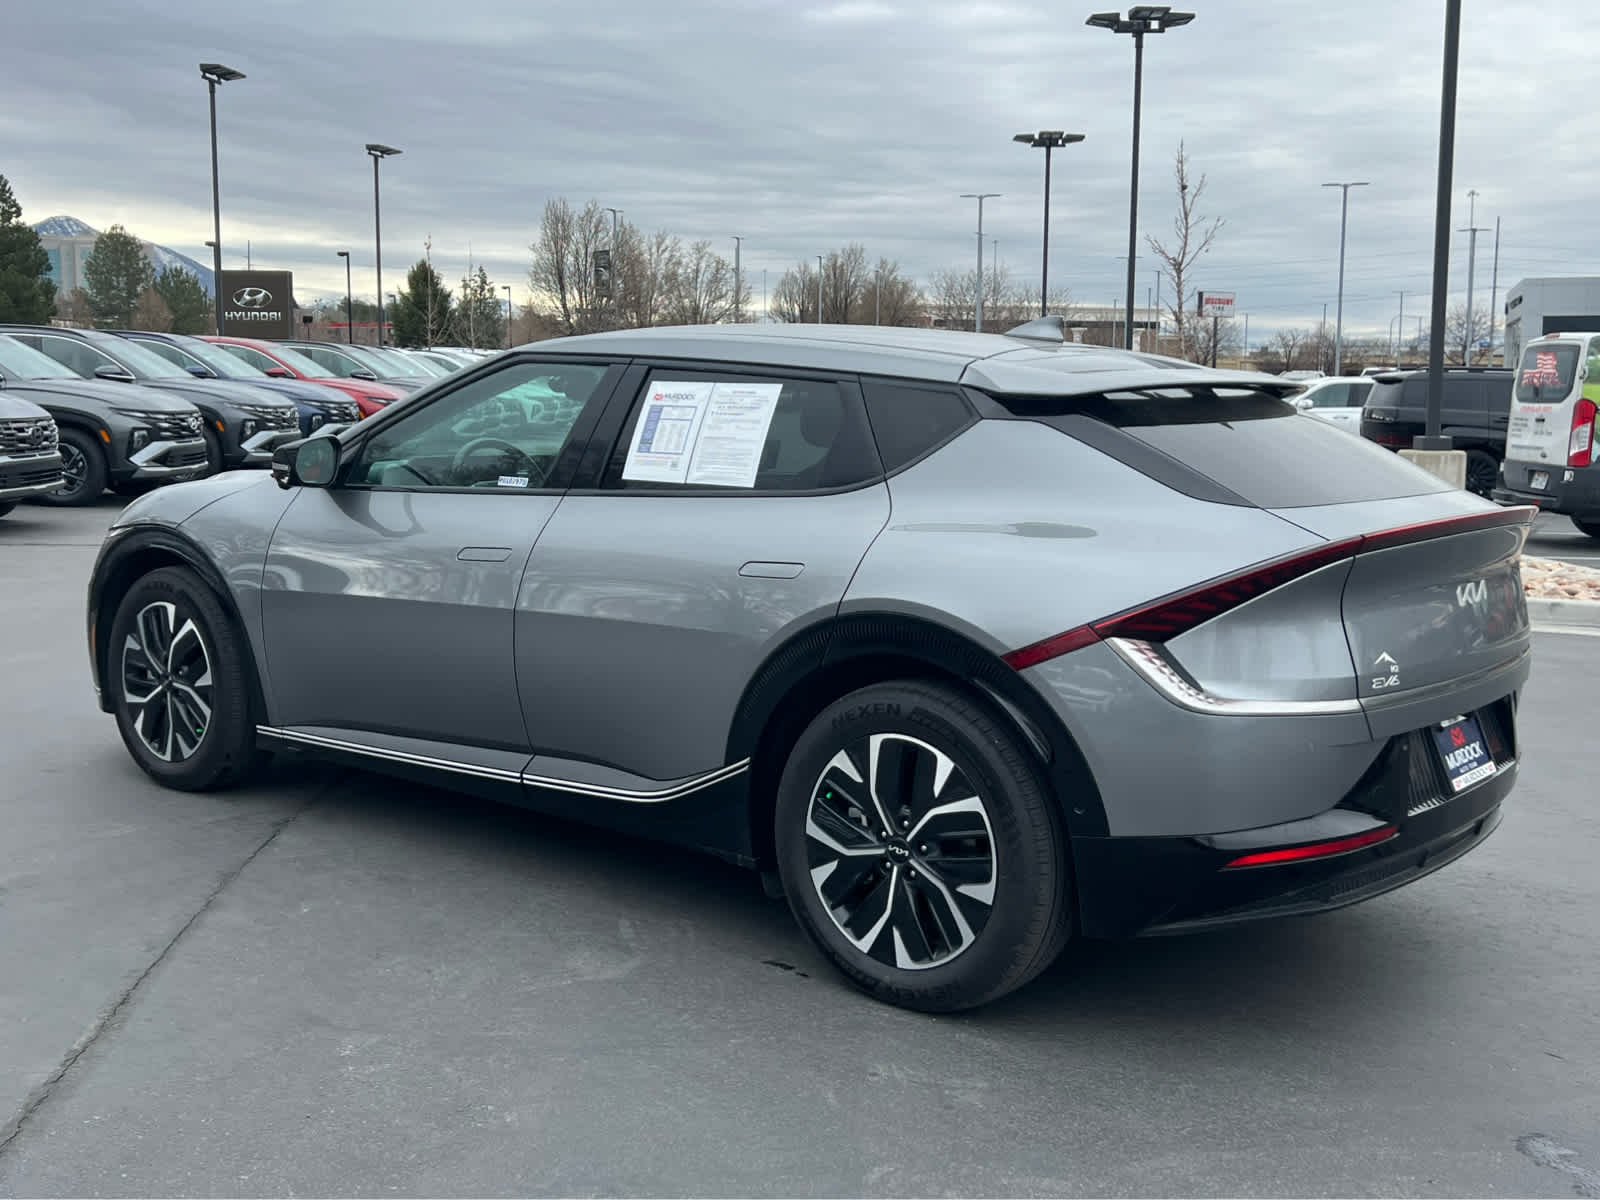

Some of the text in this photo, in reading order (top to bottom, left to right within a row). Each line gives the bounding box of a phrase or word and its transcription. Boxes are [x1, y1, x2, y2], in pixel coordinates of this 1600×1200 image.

[1204, 297, 1233, 306] DISCOUNT
[224, 311, 282, 321] HYUNDAI
[1456, 579, 1488, 607] KIA
[1372, 674, 1401, 689] EV6
[831, 703, 902, 728] NEXEN
[1444, 741, 1484, 770] MURDOCK
